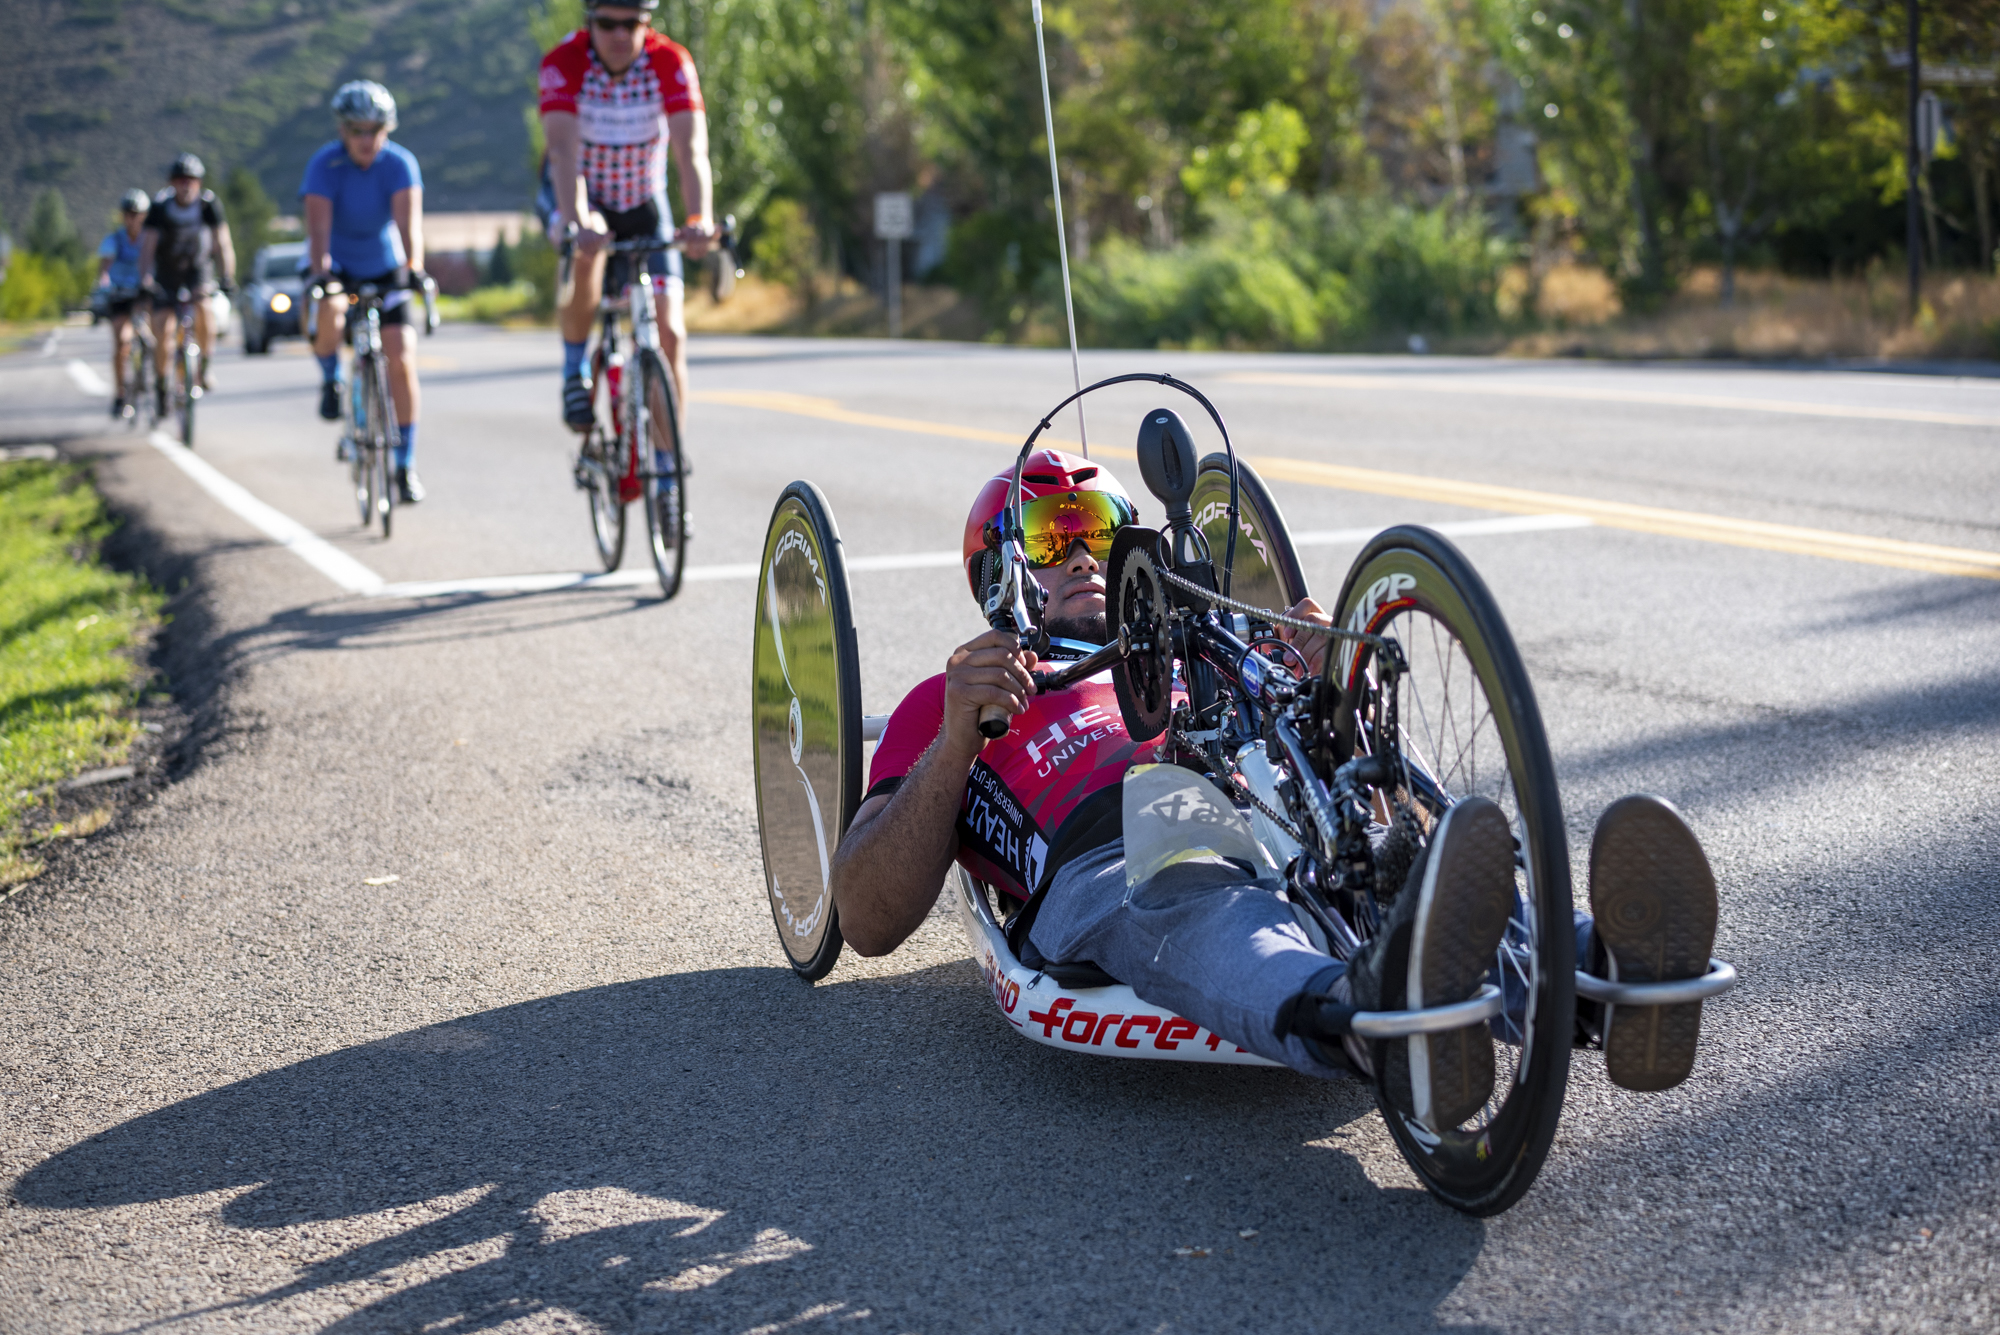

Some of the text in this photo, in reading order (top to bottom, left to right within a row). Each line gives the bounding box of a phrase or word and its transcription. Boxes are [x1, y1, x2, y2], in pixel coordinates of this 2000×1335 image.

[1193, 501, 1268, 567] CORMA
[1025, 704, 1121, 764] HE
[966, 787, 1020, 871] HEALT
